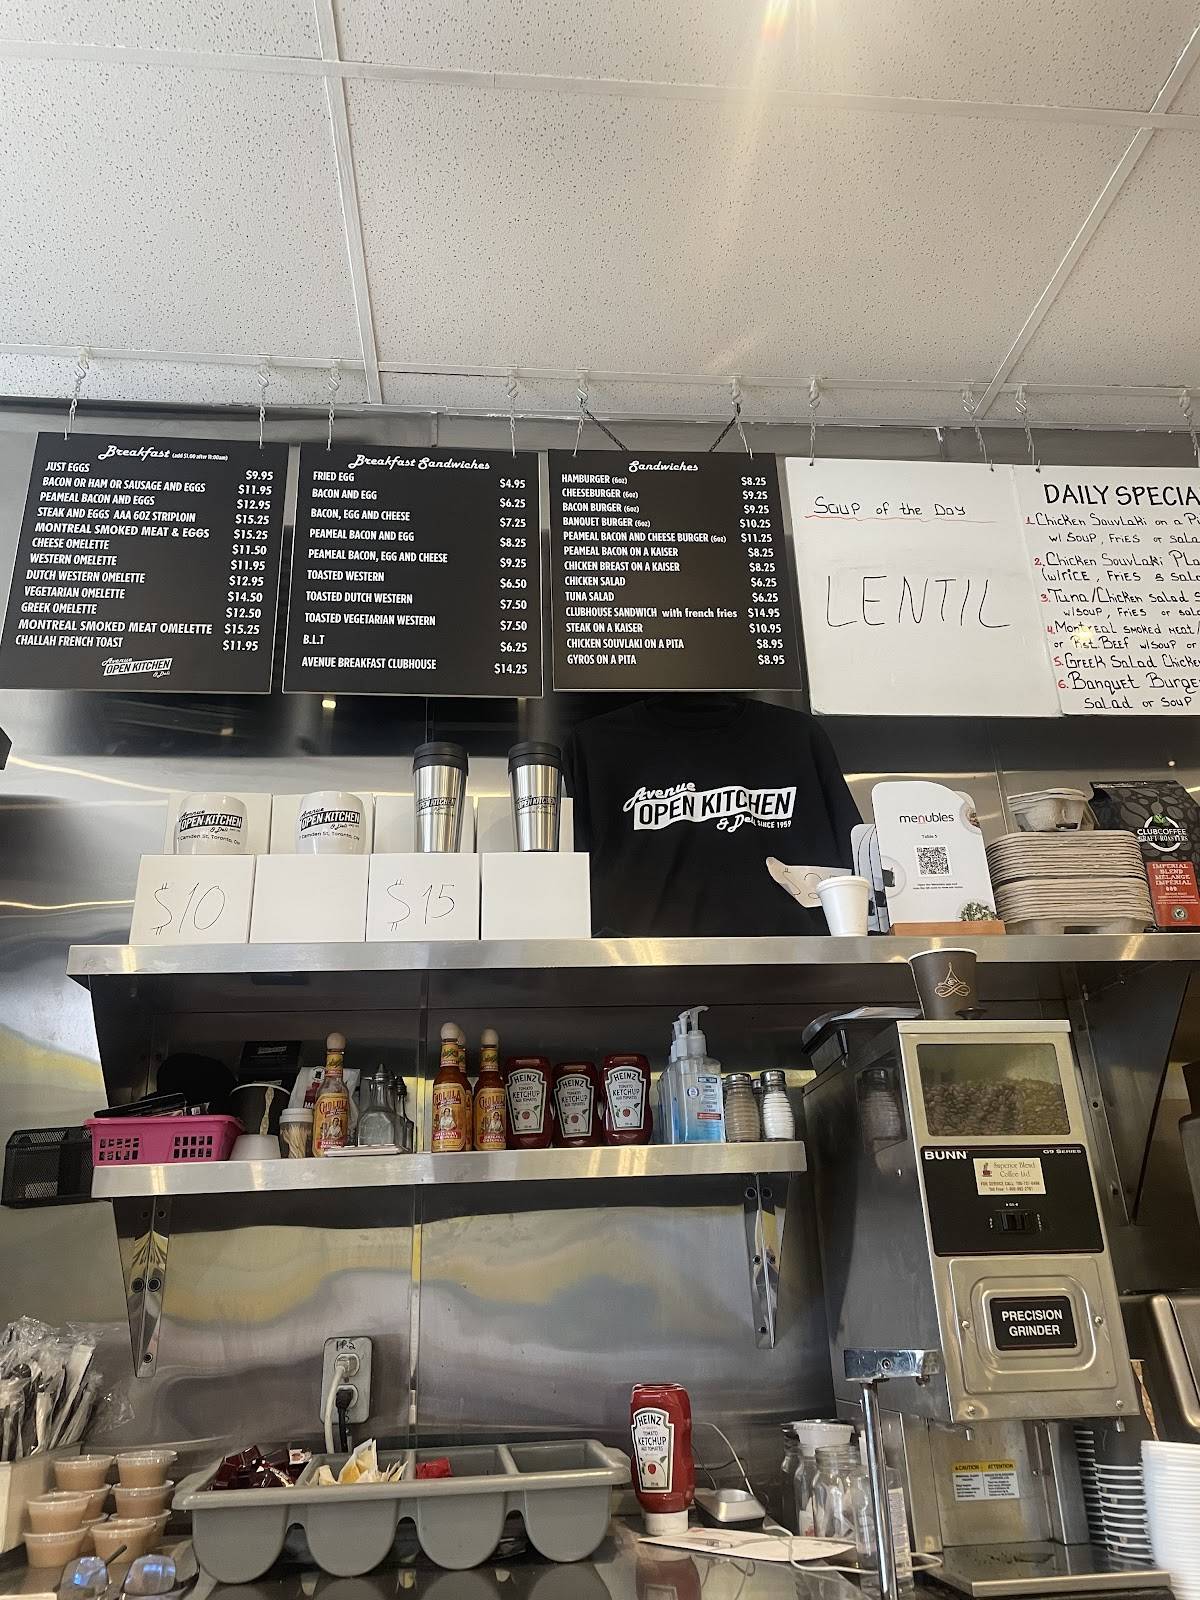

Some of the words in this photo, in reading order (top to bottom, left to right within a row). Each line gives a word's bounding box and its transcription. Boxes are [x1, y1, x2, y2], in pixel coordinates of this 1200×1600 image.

[98, 445, 170, 462] Breakfast
[44, 461, 67, 471] JUST
[67, 462, 90, 472] EGGS
[348, 454, 416, 470] Breakfast
[418, 456, 490, 470] Sandwiches
[628, 461, 698, 472] Sandwiches
[245, 469, 273, 480] $9.95
[313, 470, 337, 481] FRIED
[338, 471, 354, 481] EGG
[561, 473, 610, 483] HAMBURGER
[42, 476, 72, 487] BACON
[73, 477, 87, 487] OR
[87, 478, 108, 488] HAM
[109, 479, 122, 489] OR
[123, 479, 162, 490] SAUSAGE
[163, 481, 182, 491] AND
[183, 482, 206, 492] EGGS
[499, 478, 525, 488] $4.95
[740, 476, 766, 486] $8.25
[237, 484, 272, 495] $11.95
[742, 490, 768, 500] $9.25
[1044, 484, 1109, 504] DAILY
[236, 498, 271, 510] $12.95
[499, 497, 525, 508] $6.25
[310, 507, 341, 520] BACON,
[343, 509, 360, 519] EGG
[360, 510, 379, 520] AND
[380, 510, 410, 521] CHEESE
[743, 504, 769, 514] $9.25
[876, 502, 890, 515] of
[899, 502, 922, 516] the
[235, 513, 269, 525] $15.25
[499, 516, 526, 528] $7.25
[562, 516, 599, 526] BANQUET
[601, 517, 633, 527] BURGER
[739, 518, 771, 528] $10.25
[233, 528, 268, 540] $15.25
[740, 532, 772, 543] $11.25
[31, 537, 65, 548] CHEESE
[65, 538, 110, 550] OMELETTE
[499, 537, 526, 548] $8.25
[231, 543, 267, 555] $11.50
[747, 547, 774, 557] $8.25
[230, 559, 265, 571] $11.95
[499, 557, 526, 568] $9.25
[748, 562, 775, 572] $8.25
[25, 569, 56, 580] DUTCH
[58, 570, 100, 582] WESTERN
[101, 571, 145, 583] OMELETTE
[228, 575, 264, 586] $12.95
[306, 569, 343, 580] TOASTED
[345, 570, 384, 582] WESTERN
[499, 578, 527, 589] $6.50
[750, 577, 777, 588] $6.25
[227, 591, 263, 602] $14.50
[751, 592, 778, 603] $6.25
[826, 575, 1012, 629] LENTIL
[20, 601, 51, 613] GREEK
[52, 602, 97, 614] OMELETTE
[499, 598, 527, 610] $7.50
[225, 607, 261, 618] $12.50
[565, 606, 612, 617] CLUBHOUSE
[613, 607, 657, 617] SANDWICH
[661, 607, 682, 617] with
[684, 607, 714, 617] french
[716, 607, 737, 618] fries
[747, 607, 780, 618] $14.95
[224, 623, 260, 634] $15.25
[500, 619, 527, 631] $7.50
[748, 622, 781, 633] $10.95
[15, 635, 57, 646] CHALLAH
[57, 635, 94, 647] FRENCH
[95, 636, 123, 647] TOAST
[302, 634, 325, 644] B.L.T
[566, 638, 601, 648] CHICKEN
[602, 638, 642, 648] SOUVLAKI
[644, 638, 656, 648] ON
[658, 638, 665, 648] A
[665, 638, 684, 648] PITA
[756, 638, 783, 649] $8.95
[222, 639, 258, 651] $11.95
[500, 641, 527, 652] $6.25
[301, 656, 336, 667] AVENUE
[337, 657, 386, 668] BREAKFAST
[387, 658, 436, 669] CLUBHOUSE
[757, 654, 785, 665] $8.95
[106, 663, 131, 674] OPEN
[132, 659, 171, 672] KITCHEN
[494, 663, 527, 674] $14.25
[622, 782, 696, 812] Avenue
[639, 795, 696, 825] OPEN
[702, 790, 792, 817] KITCHEN
[181, 816, 204, 830] OPEN
[205, 814, 243, 828] KITCHEN
[301, 815, 324, 830] OPEN
[325, 811, 360, 825] KITCHEN
[899, 812, 954, 824] menubles
[776, 820, 792, 829] 1959
[1136, 828, 1186, 836] CLUBCOFFEE
[151, 882, 226, 935] $10
[386, 879, 455, 932] $15
[514, 1074, 537, 1084] HEINZ
[614, 1072, 636, 1080] HEINZ
[562, 1080, 584, 1088] HEINZ
[612, 1088, 640, 1096] KETCHUP
[560, 1095, 588, 1103] KETCHUP
[924, 1151, 967, 1160] BUNN
[994, 1162, 1018, 1170] Superior
[1002, 1309, 1062, 1322] PRECISION
[1008, 1324, 1061, 1337] GRINDER
[638, 1415, 662, 1426] HEINZ
[638, 1436, 667, 1446] KETCHUP
